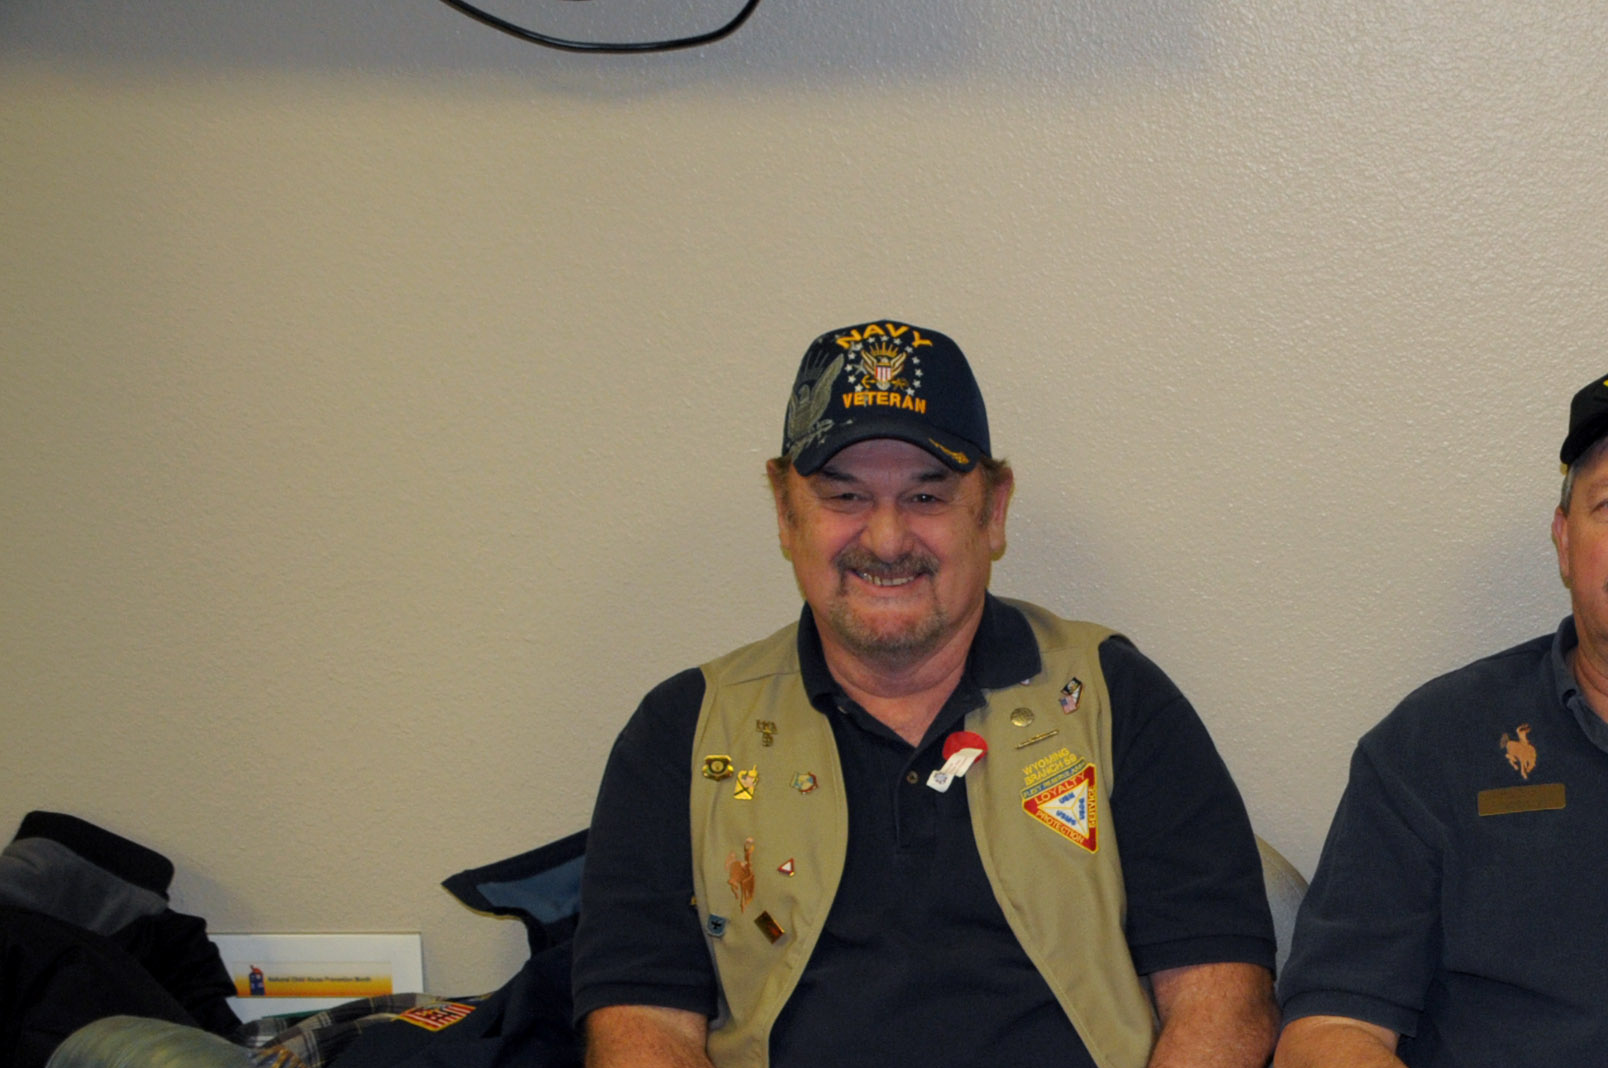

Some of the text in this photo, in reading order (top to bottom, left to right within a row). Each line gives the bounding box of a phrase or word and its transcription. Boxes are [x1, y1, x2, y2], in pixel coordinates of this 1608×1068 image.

[836, 323, 933, 349] NAVY
[842, 391, 927, 414] VETERAN
[1022, 747, 1070, 775] WYOMING
[1024, 762, 1063, 786] BRANCH
[1064, 753, 1077, 765] 59
[1034, 773, 1086, 804] LOYALTY
[1035, 811, 1085, 843] PROTECTION
